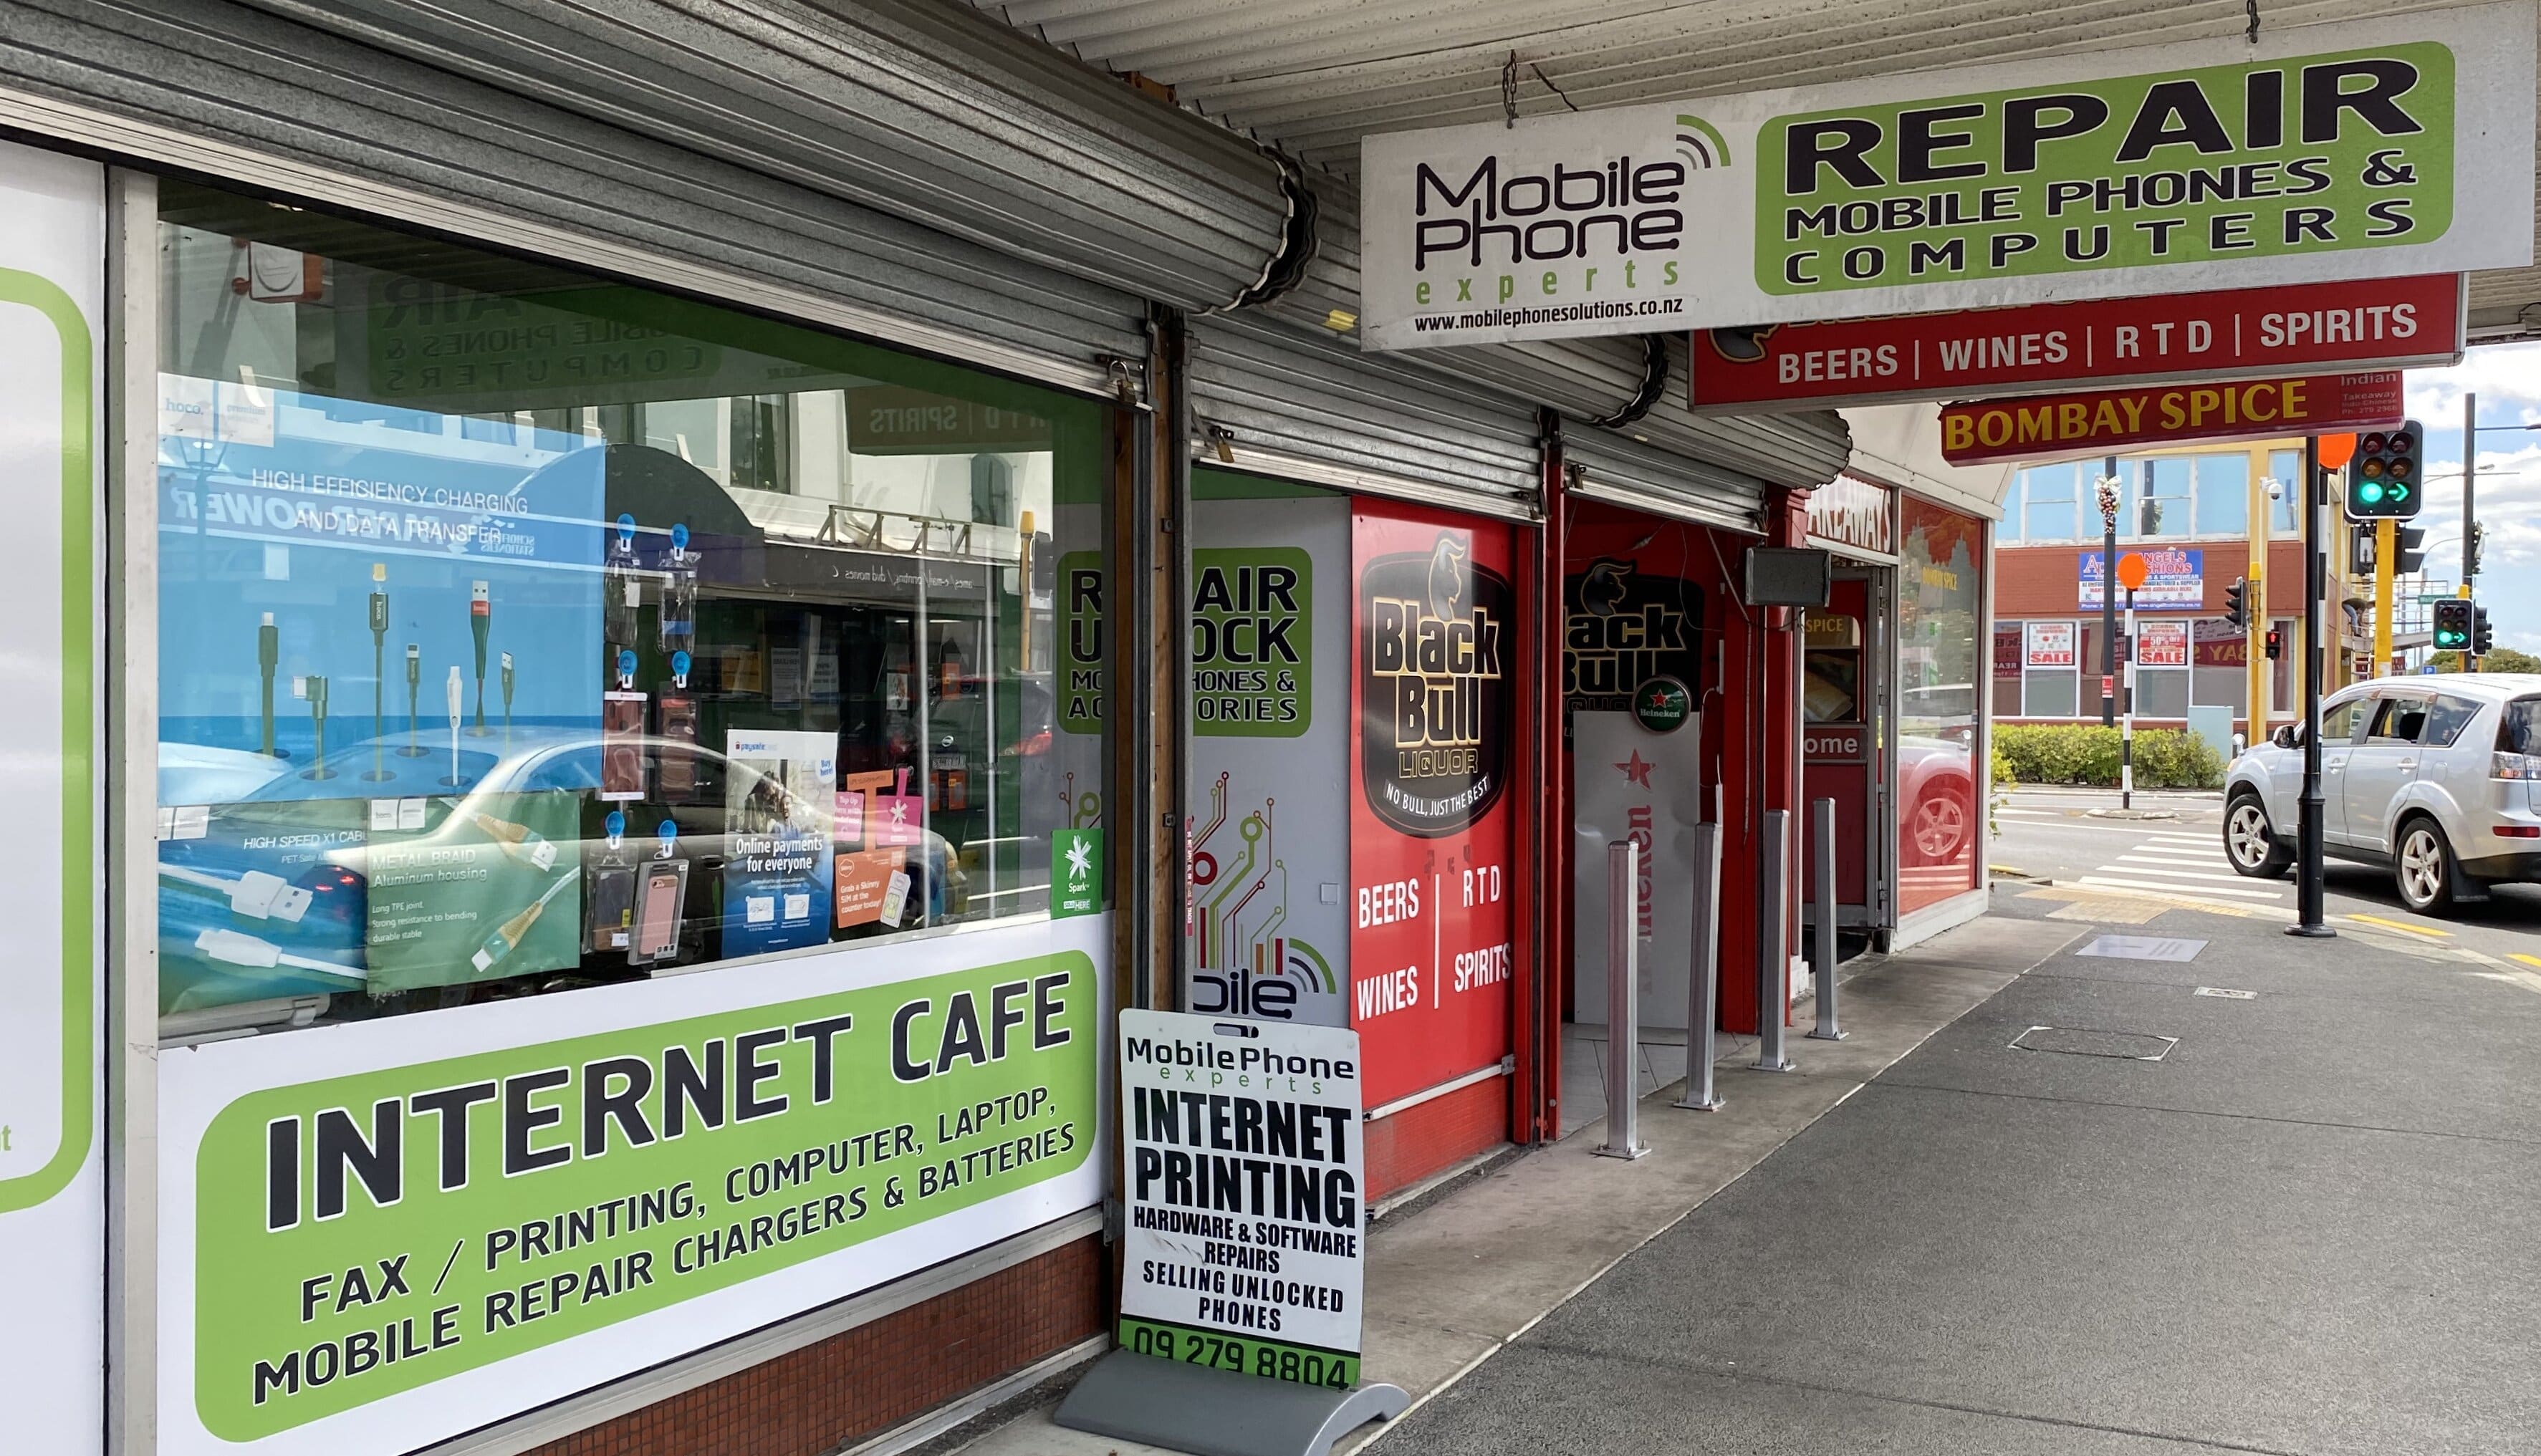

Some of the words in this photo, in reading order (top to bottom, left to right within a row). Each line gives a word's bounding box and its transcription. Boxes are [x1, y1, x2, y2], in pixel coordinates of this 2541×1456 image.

[1785, 59, 2424, 196] REPAIR
[1415, 155, 1685, 221] Mobile
[1784, 185, 2022, 241] MOBILE
[2046, 157, 2331, 218] PHONES
[2360, 150, 2418, 189] &
[1415, 199, 1683, 271] Phone
[1783, 200, 2415, 286] COMPUTERS
[1416, 259, 1678, 304] experts
[1415, 296, 1683, 332] www.mobilephonesolutions.co.nz
[1779, 344, 1898, 383] BEERS
[1939, 331, 2068, 371] WINES
[2259, 303, 2417, 348] SPIRITS
[2341, 373, 2396, 386] Indian
[2343, 391, 2396, 400] Takeaway
[165, 397, 204, 415] hoco.
[1946, 396, 2148, 450] BOMBAY
[2159, 380, 2308, 430] SPICE
[252, 468, 305, 493] HIGH
[313, 474, 428, 503] EFFICIENCY
[435, 488, 528, 514] CHARGING
[294, 511, 338, 531] AND
[345, 514, 399, 535] DATA
[405, 520, 502, 546] TRANSFER
[1805, 476, 1891, 554] AKEAWAYS
[2145, 563, 2193, 574] SHIONS
[1372, 597, 1502, 680] Black
[1564, 603, 1687, 652] ack
[1805, 617, 1844, 632] SPICE
[2151, 636, 2169, 646] 50%
[2030, 653, 2071, 663] SALE
[2141, 652, 2184, 663] SALE
[1275, 670, 1296, 693] &
[1395, 673, 1481, 748] Bull
[1640, 708, 1681, 718] Heineken
[821, 759, 831, 768] Buy
[1398, 748, 1479, 779] LIQUOR
[1386, 783, 1401, 806] NO
[1429, 798, 1450, 817] JUST
[1449, 794, 1468, 814] THE
[1467, 776, 1489, 806] BEST
[244, 836, 276, 850] HIGH
[279, 834, 321, 848] SPEED
[323, 831, 335, 844] X1
[339, 829, 368, 844] CABL
[736, 837, 772, 854] Online
[773, 837, 822, 857] payments
[373, 853, 422, 871] METAL
[431, 849, 476, 865] BRAID
[373, 872, 434, 888] Aluminum
[438, 867, 488, 882] housing
[746, 855, 763, 872] for
[764, 857, 813, 874] everyone
[840, 884, 855, 894] Grab
[860, 880, 880, 889] Skinny
[1068, 882, 1087, 894] Spark
[1358, 878, 1419, 929] BEERS
[372, 905, 390, 914] Long
[392, 902, 405, 911] TPE
[372, 919, 396, 928] Strong
[398, 915, 433, 925] resistance
[445, 910, 478, 920] bending
[841, 903, 863, 914] counter
[373, 932, 400, 943] durable
[402, 930, 423, 940] stable
[1357, 965, 1418, 1021] WINES
[1454, 942, 1512, 993] SPIRITS
[1160, 1066, 1322, 1095] experts
[266, 1013, 853, 1233] INTERNET
[890, 972, 1071, 1084] CAFE
[1133, 1086, 1352, 1165] INTERNET
[301, 1253, 411, 1324] FAX
[431, 1239, 465, 1296] /
[486, 1179, 706, 1272] PRINTING,
[725, 1123, 923, 1205] COMPUTER,
[937, 1086, 1057, 1145] LAPTOP,
[1135, 1146, 1356, 1229] PRINTING
[1133, 1206, 1234, 1240] HARDWARE
[1238, 1223, 1252, 1243] &
[1255, 1222, 1357, 1258] SOFTWARE
[251, 1304, 462, 1407] MOBILE
[484, 1251, 655, 1335] REPAIR
[672, 1187, 868, 1274] CHARGERS
[882, 1177, 906, 1210] &
[918, 1122, 1075, 1200] BATTERIES
[1204, 1241, 1280, 1274] REPAIRS
[1143, 1260, 1226, 1295] SELLING
[1231, 1273, 1344, 1313] UNLOCKED
[1198, 1297, 1281, 1332] PHONES
[1134, 1326, 1175, 1359] 09
[1186, 1335, 1244, 1374] 279
[1257, 1347, 1350, 1391] 8804
